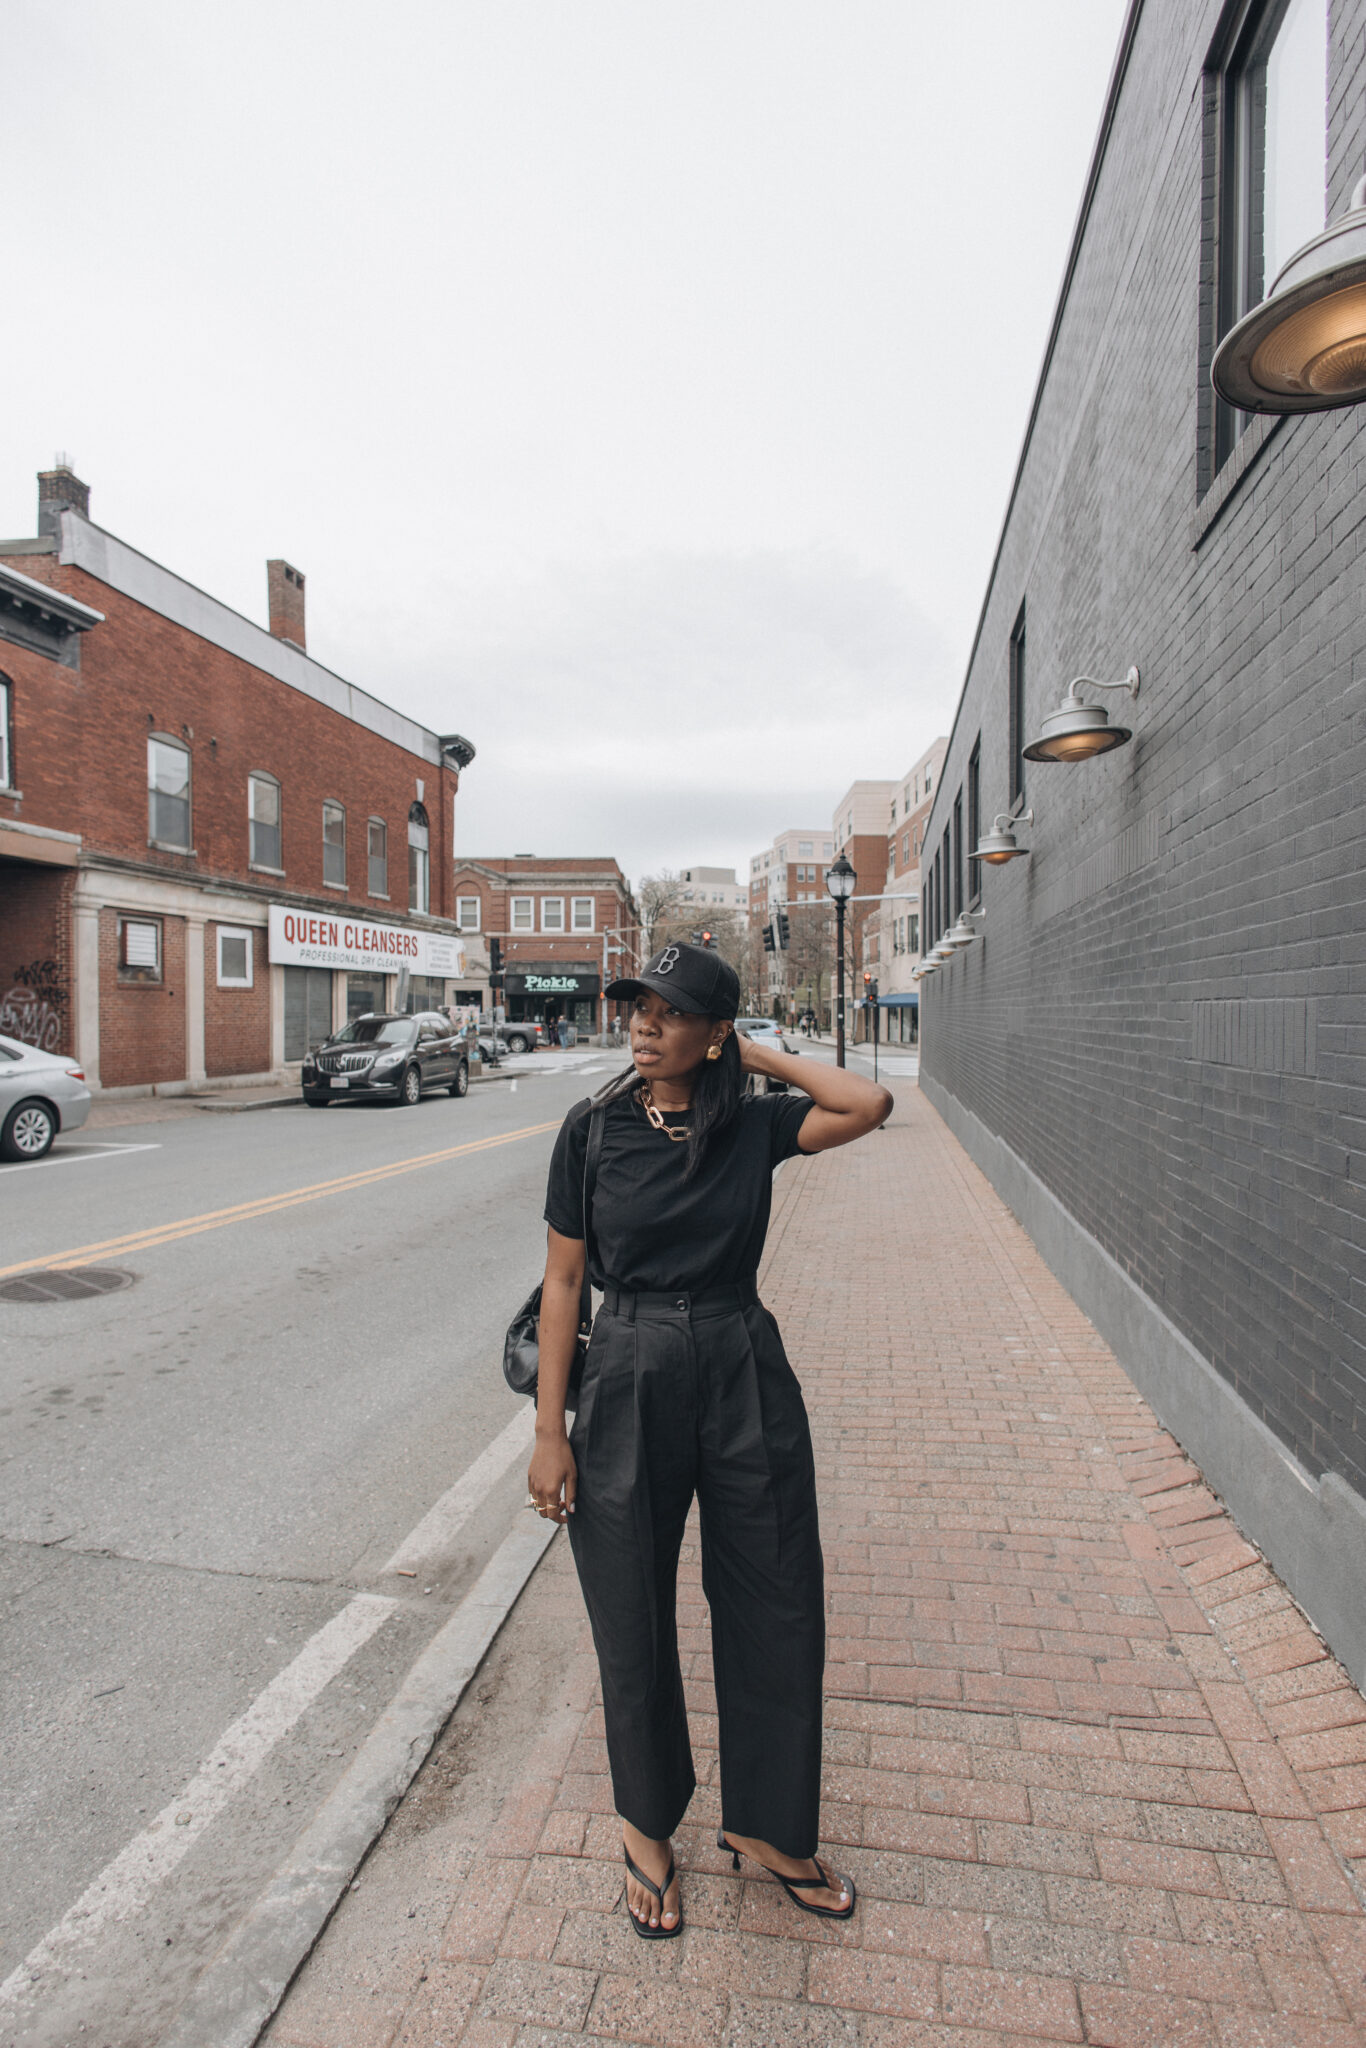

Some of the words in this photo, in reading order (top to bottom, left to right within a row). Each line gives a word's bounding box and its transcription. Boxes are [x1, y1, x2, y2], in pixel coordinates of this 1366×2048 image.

[284, 915, 338, 947] QUEEN
[344, 925, 418, 957] CLEANSERS
[299, 949, 359, 965] PROFESSIONAL
[361, 955, 375, 966] DRY
[376, 957, 409, 969] CLEANING
[651, 946, 680, 975] B
